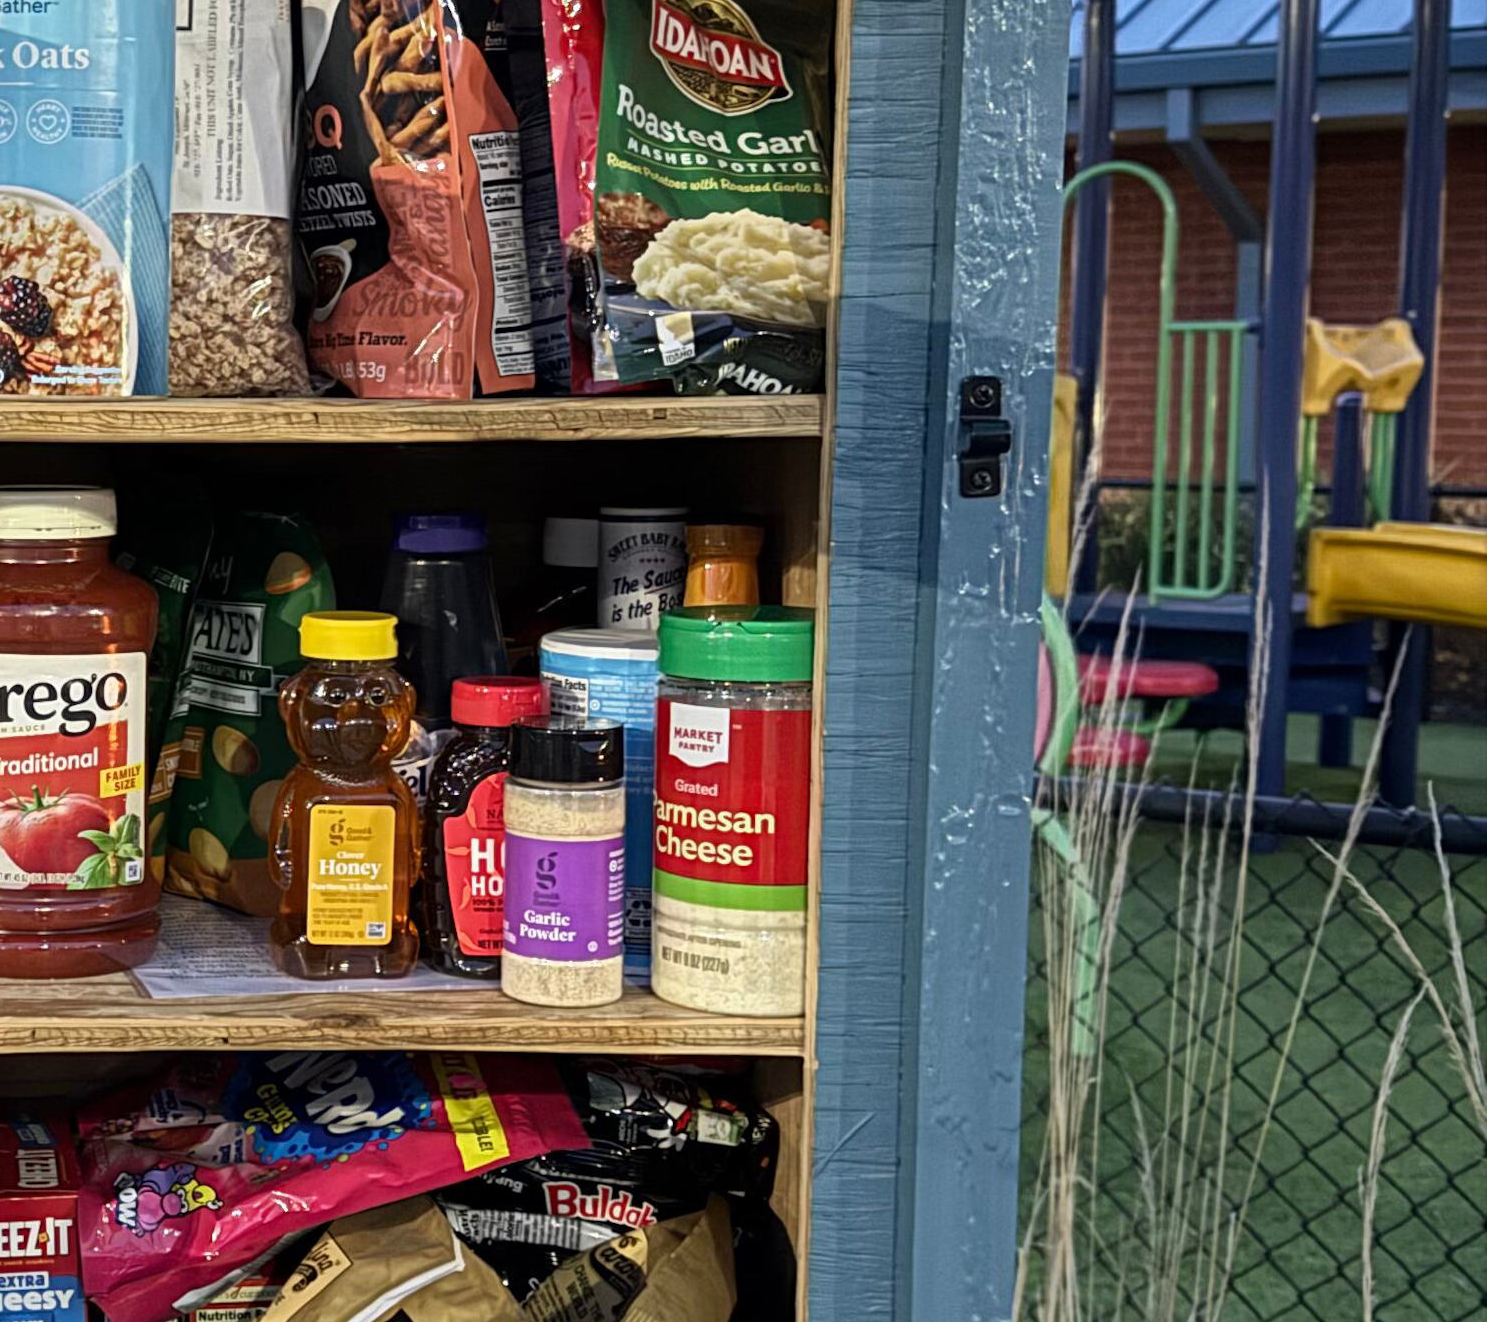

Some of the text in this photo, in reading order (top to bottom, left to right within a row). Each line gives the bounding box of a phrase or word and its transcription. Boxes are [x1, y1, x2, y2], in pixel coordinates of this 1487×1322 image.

[655, 6, 777, 82] IDAHOAN
[12, 40, 90, 70] Oats
[616, 84, 728, 155] Roasted
[627, 136, 709, 165] MASHED
[689, 178, 719, 191] with
[720, 178, 771, 193] Roasted
[358, 332, 408, 346] Flavor.
[613, 576, 639, 596] The
[612, 600, 653, 622] is the
[12, 725, 46, 733] SAUCE
[674, 727, 724, 743] MARKET
[105, 765, 142, 782] FAMILY
[113, 777, 137, 791] SIZE
[674, 779, 719, 797] Grated
[656, 825, 754, 867] Cheese
[319, 859, 382, 880] Honey
[523, 910, 571, 928] Garlic
[519, 924, 577, 942] Powder
[198, 1310, 251, 1322] Nutrition
